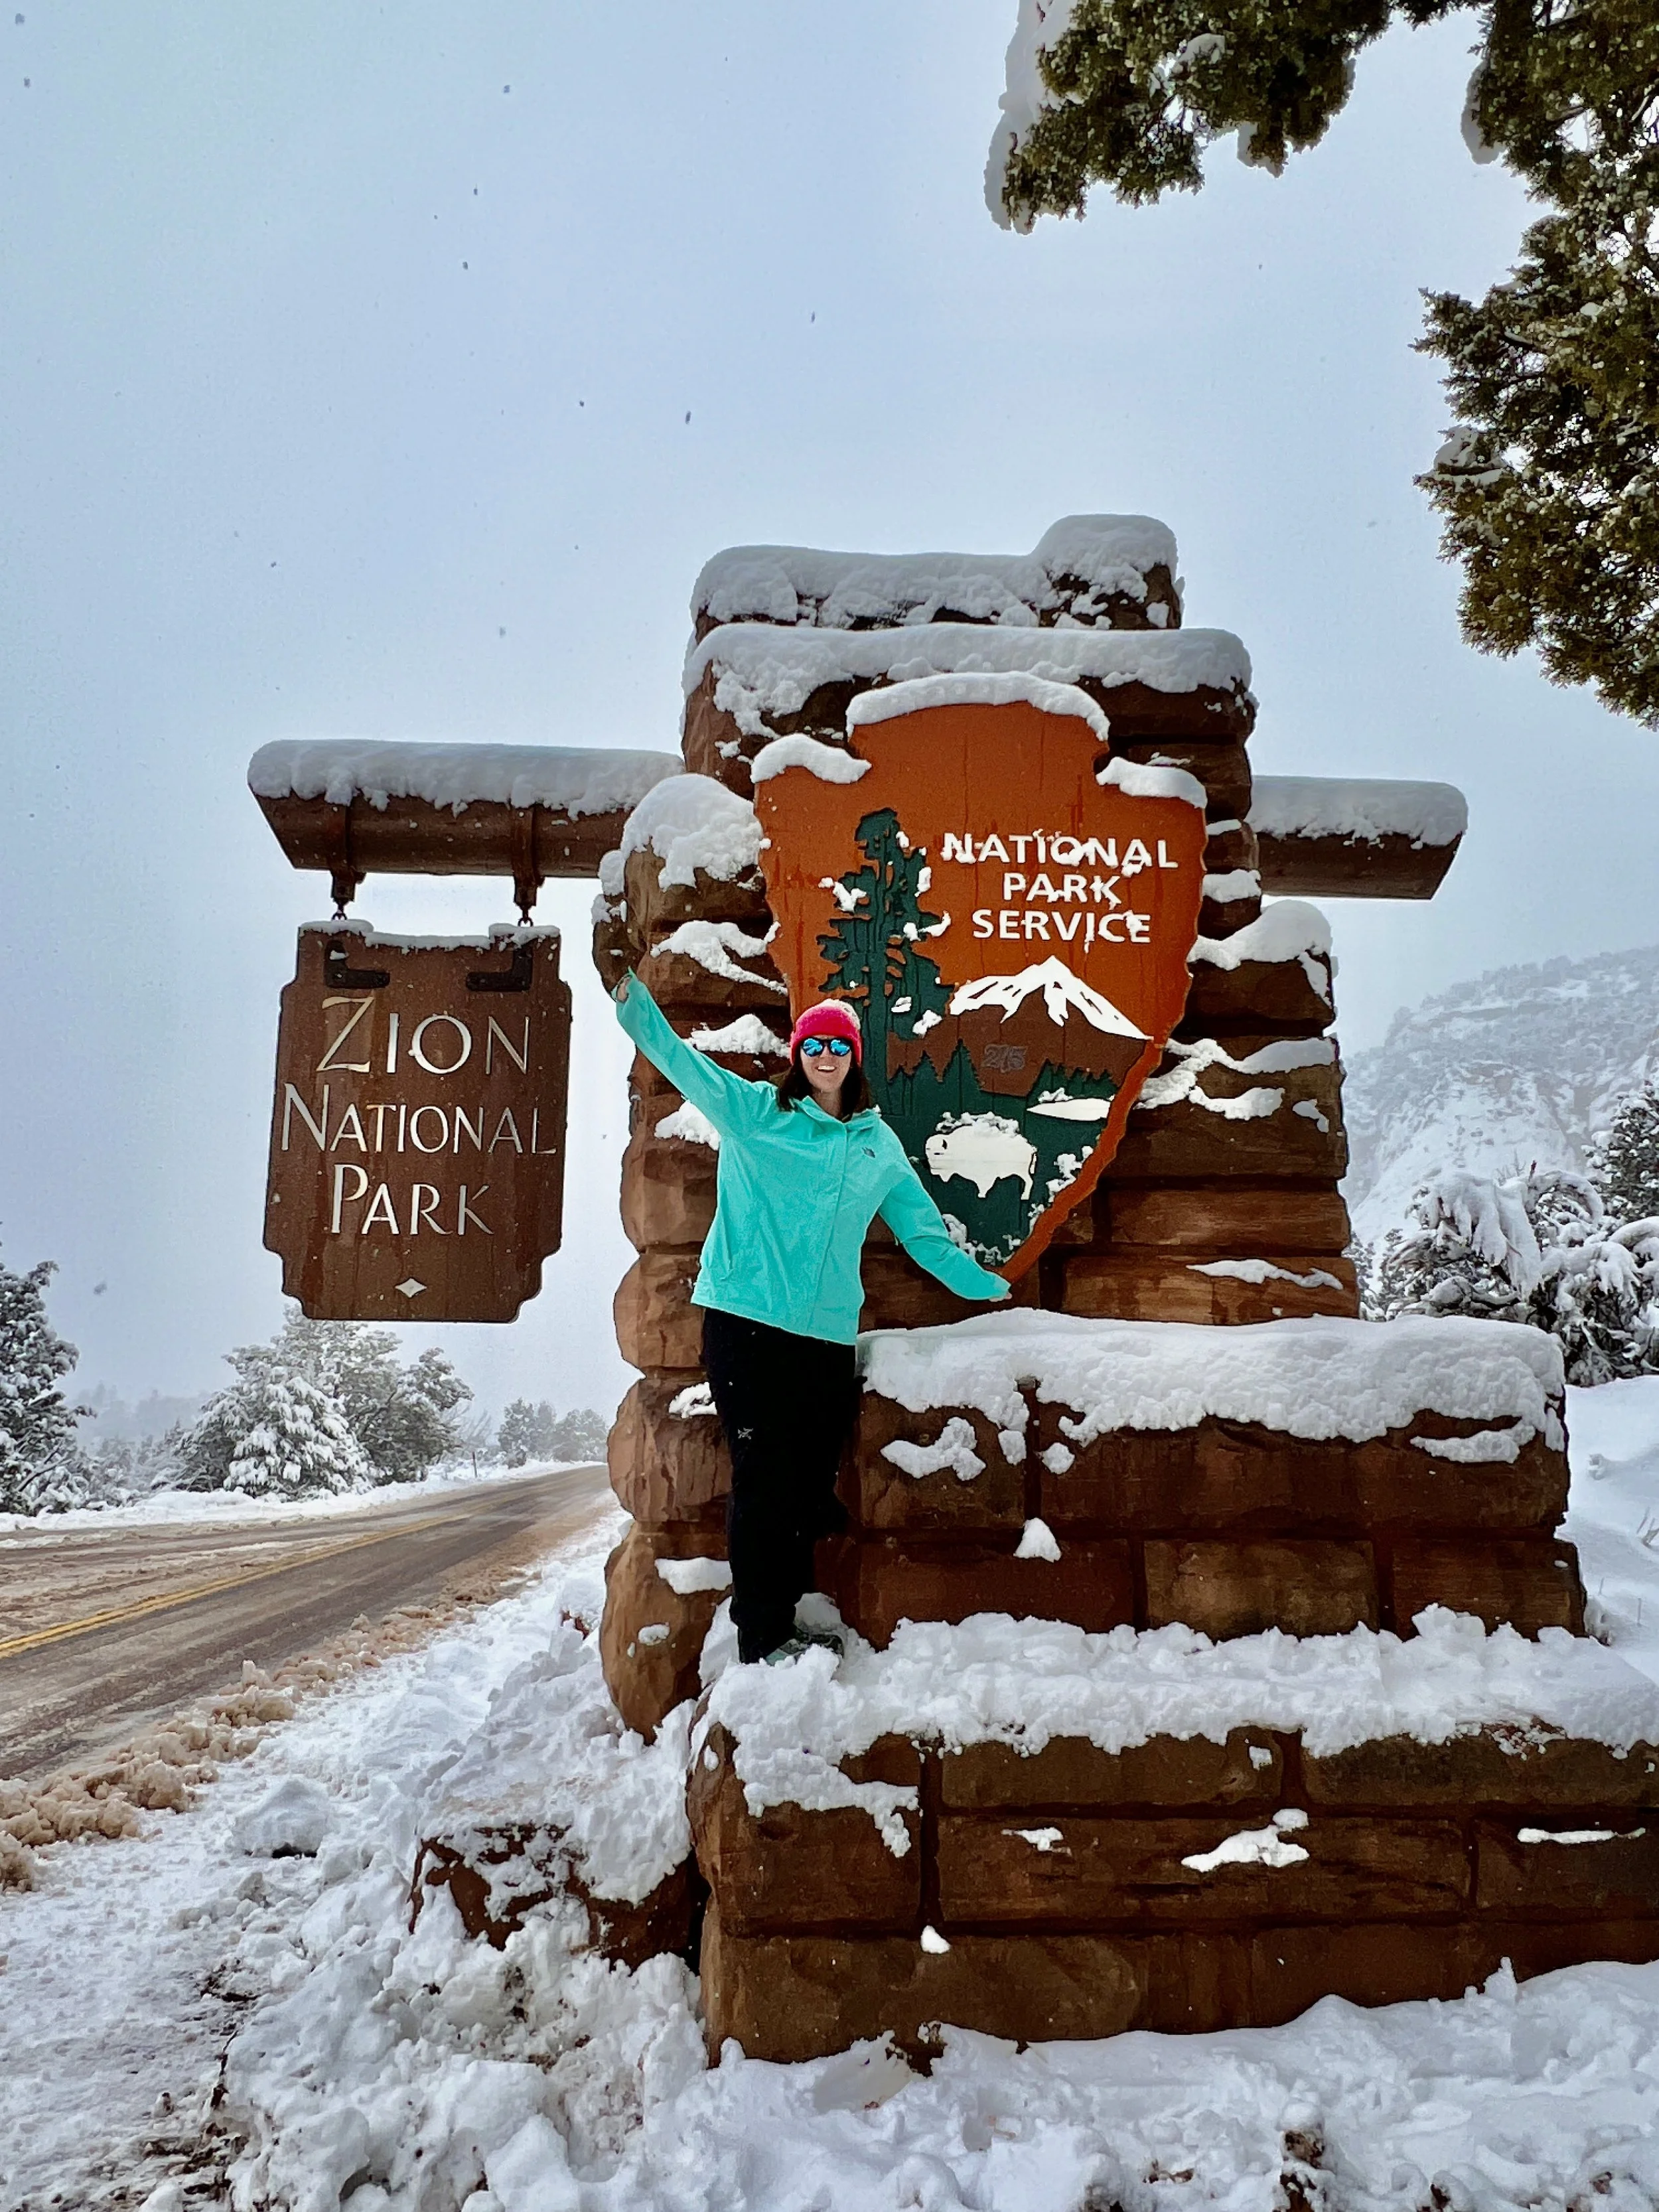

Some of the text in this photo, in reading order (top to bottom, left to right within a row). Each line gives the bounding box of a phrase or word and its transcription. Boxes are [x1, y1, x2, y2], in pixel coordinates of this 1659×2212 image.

[943, 832, 1179, 869] NATIONAL
[1003, 873, 1121, 905] PARK
[972, 909, 1151, 943] SERVICE
[316, 995, 530, 1076] ZION
[281, 1082, 557, 1155] NATIONAL
[330, 1163, 494, 1236] PARK
